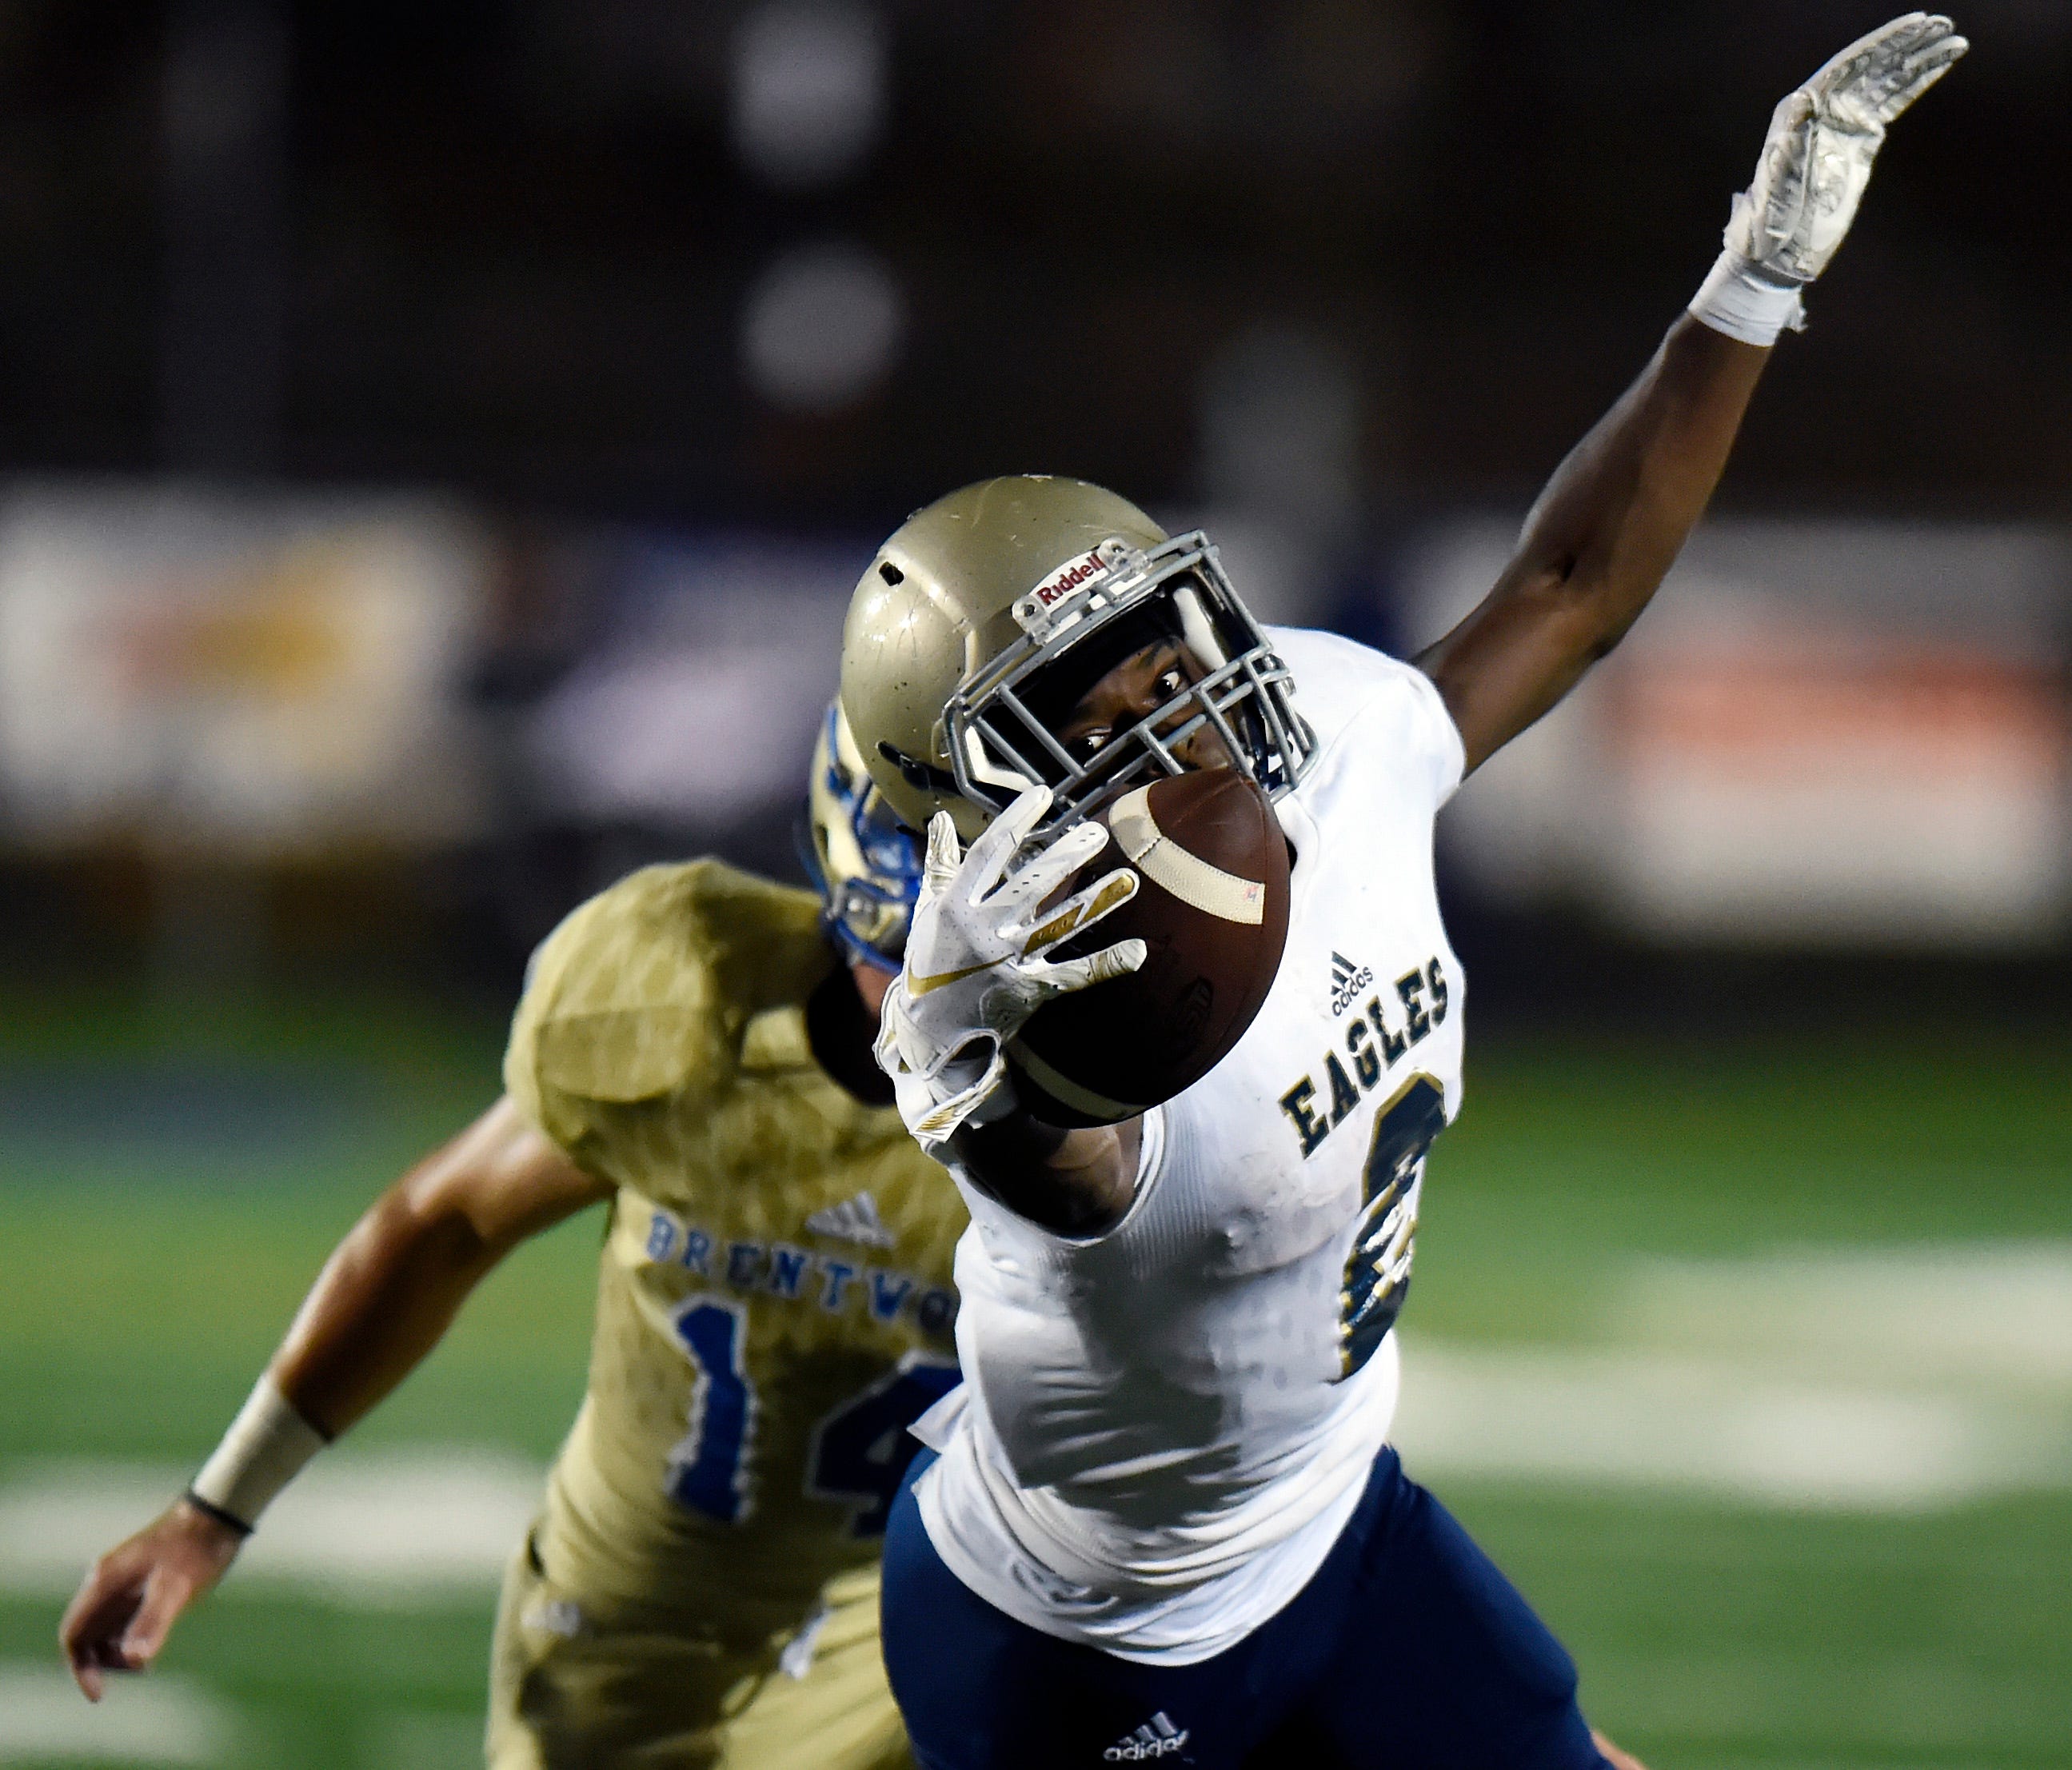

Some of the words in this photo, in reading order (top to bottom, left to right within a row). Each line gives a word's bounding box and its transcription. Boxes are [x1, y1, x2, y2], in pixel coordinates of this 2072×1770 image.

[1036, 553, 1107, 606] Riddell
[1331, 966, 1373, 1017] adidas
[1278, 955, 1448, 1160] EAGLES
[662, 1293, 964, 1540] 14
